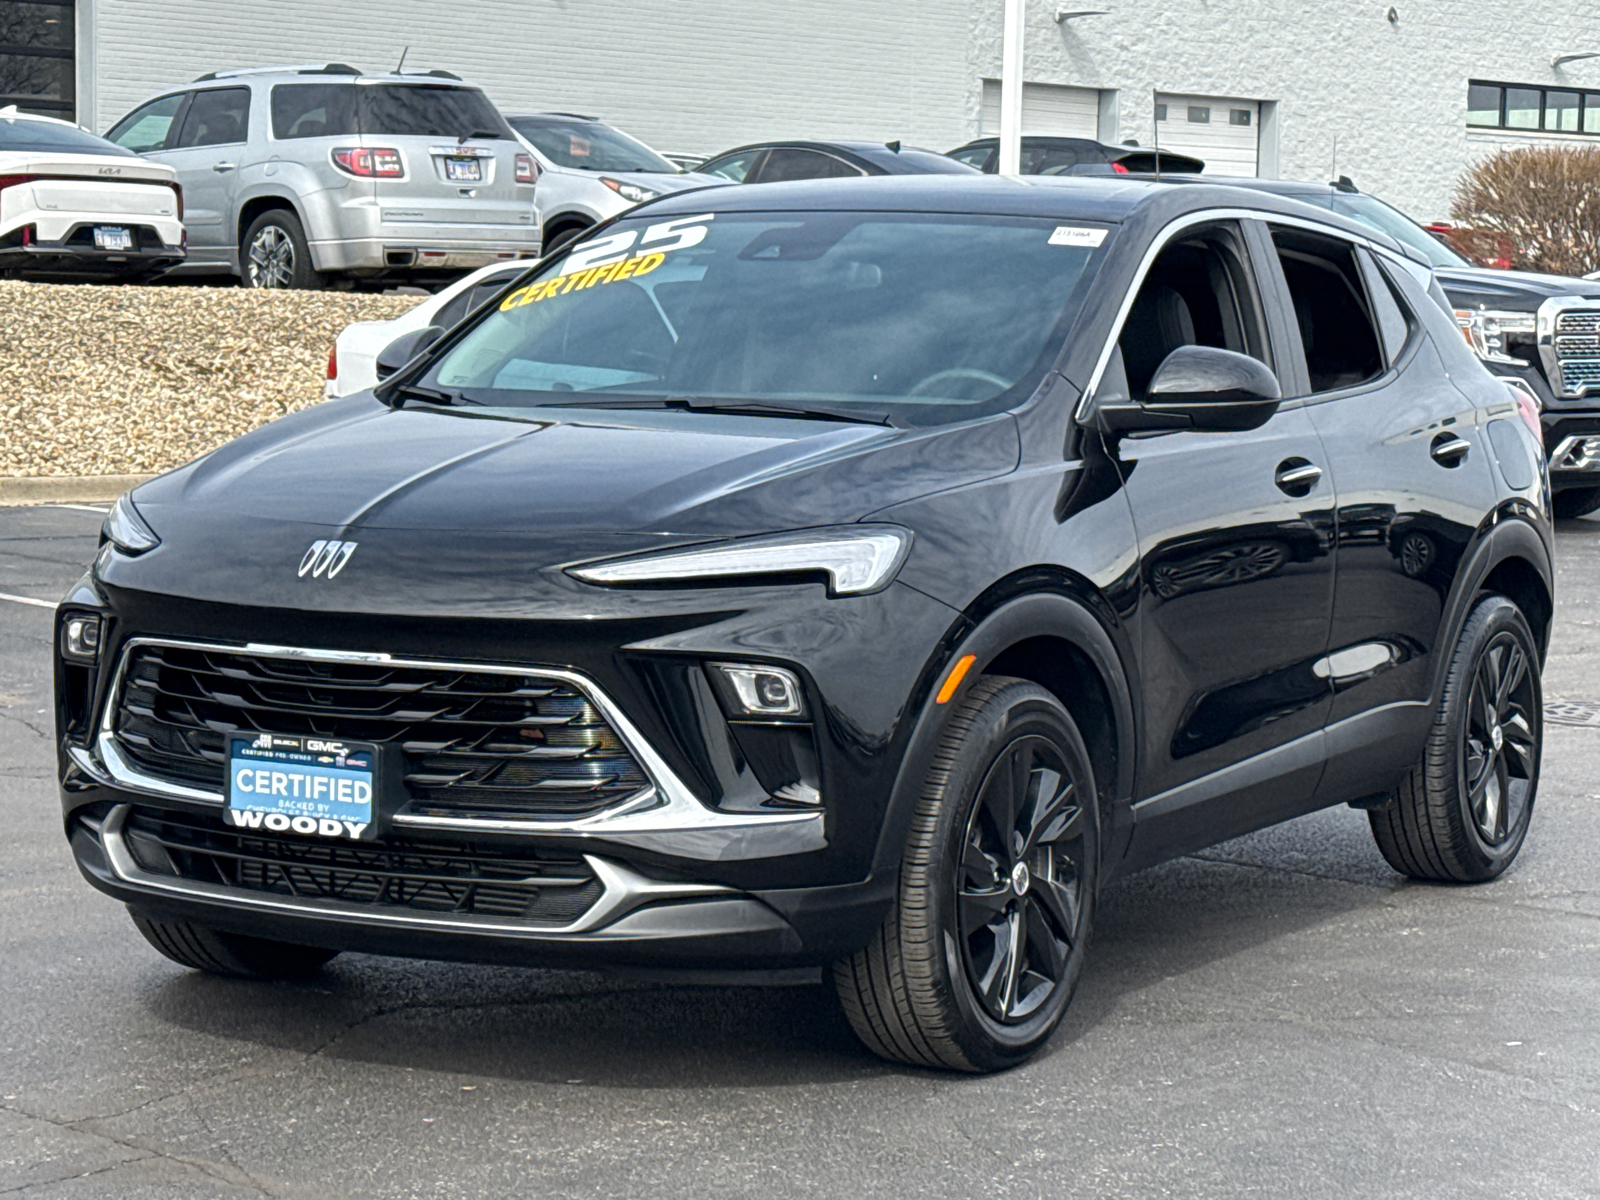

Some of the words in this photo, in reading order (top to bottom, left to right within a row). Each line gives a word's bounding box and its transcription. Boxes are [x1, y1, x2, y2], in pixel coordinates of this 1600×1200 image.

[559, 213, 714, 277] 25
[499, 252, 666, 312] CERTIFIED
[241, 749, 274, 757] CERTIFIED
[275, 752, 312, 761] PRE-OWNED
[307, 739, 343, 753] GMC
[236, 768, 372, 805] CERTIFIED
[278, 800, 314, 810] BACKED
[317, 803, 330, 813] BY
[231, 809, 368, 839] WOODY
